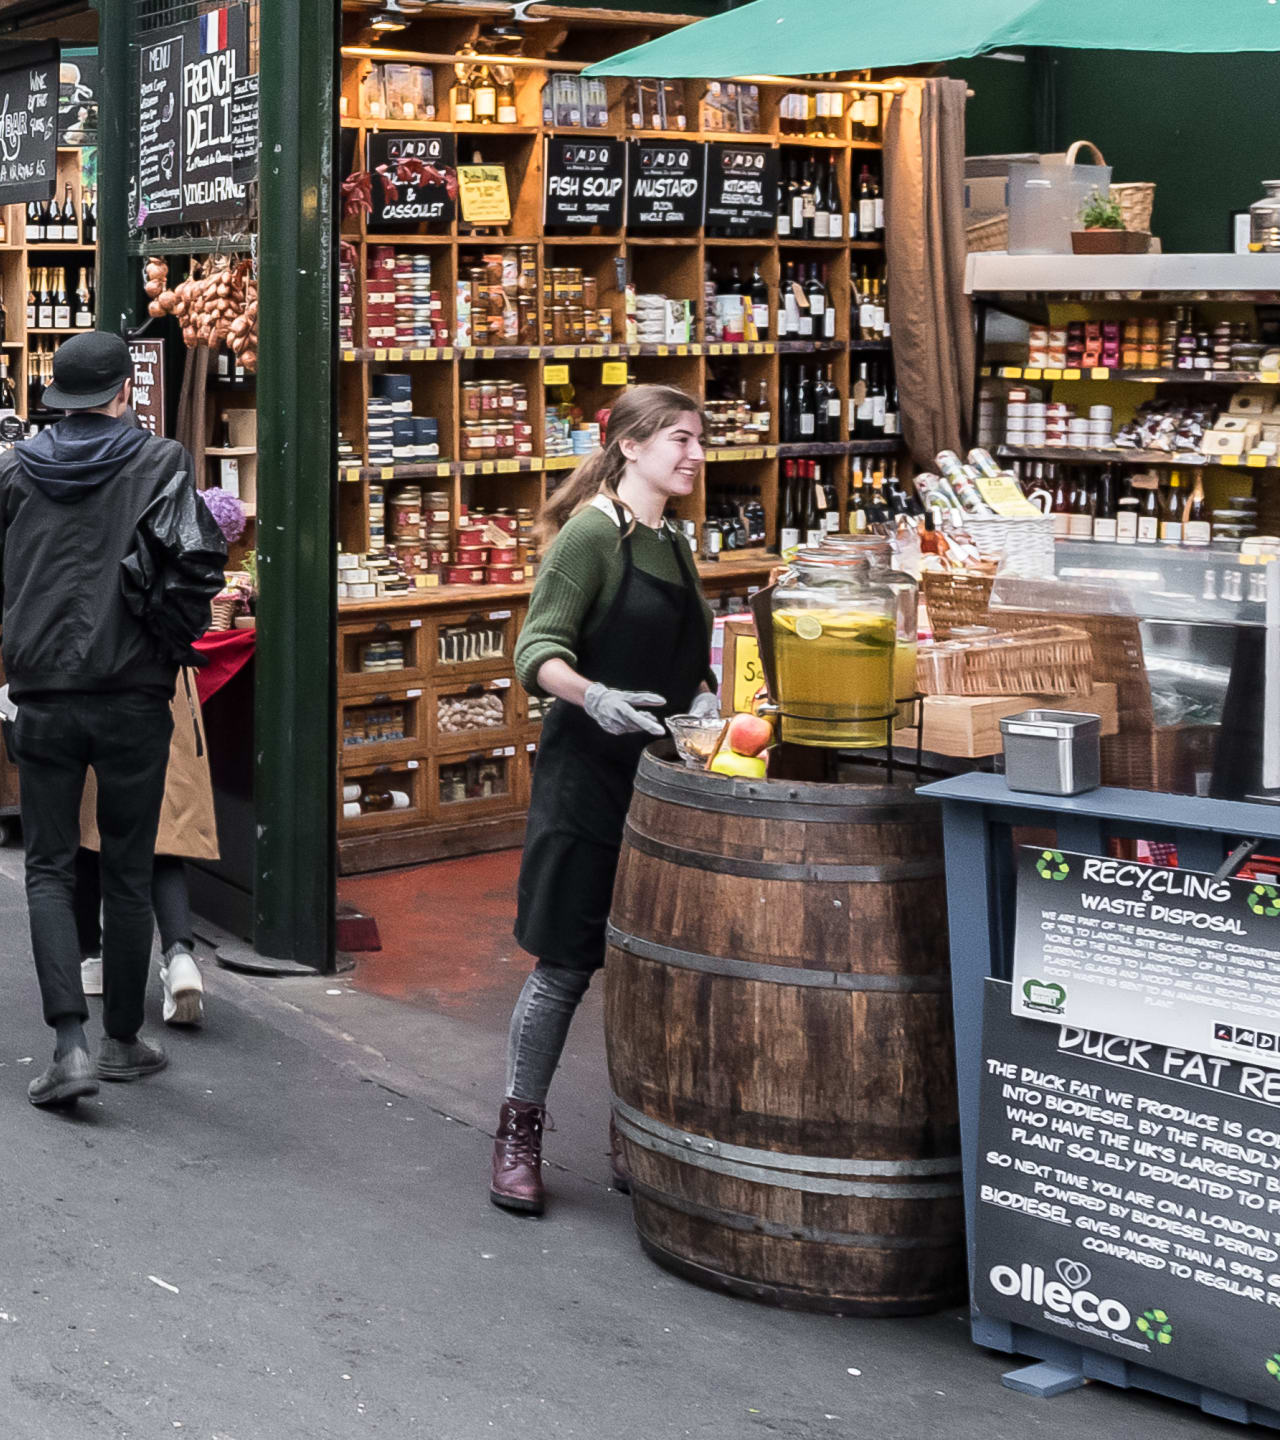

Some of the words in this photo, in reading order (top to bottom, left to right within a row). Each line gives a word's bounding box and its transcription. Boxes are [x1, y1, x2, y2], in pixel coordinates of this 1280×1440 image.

[149, 44, 171, 72] MENU
[184, 49, 236, 108] FRENCH
[186, 96, 232, 156] DELI
[407, 188, 416, 202] &
[549, 176, 580, 197] FISH
[582, 176, 622, 197] SOUP
[634, 178, 698, 198] MUSTARD
[723, 179, 762, 194] KITCHEN
[382, 203, 444, 219] CASSOULET
[1083, 859, 1231, 902] RECYCLING
[1142, 890, 1155, 901] &
[1040, 921, 1056, 930] OF
[1076, 927, 1090, 937] TO
[1091, 930, 1132, 945] LANDFILL
[1135, 939, 1156, 949] SITE
[1041, 910, 1057, 920] WE
[1057, 913, 1076, 924] ARE
[1077, 915, 1101, 927] PART
[1101, 921, 1116, 930] OF
[1117, 923, 1135, 934] THE
[1136, 926, 1184, 942] BOROUGH
[1185, 936, 1224, 950] MARKET
[1081, 893, 1146, 918] WASTE
[1151, 905, 1247, 936] DISPOSAL
[1045, 933, 1072, 945] NONE
[1072, 938, 1088, 947] OF
[1089, 940, 1106, 951] THE
[1198, 961, 1213, 970] OF
[1124, 958, 1139, 968] TO
[1057, 1024, 1152, 1069] DUCK
[1163, 1048, 1231, 1087] FAT
[986, 1059, 1017, 1079] THE
[1021, 1068, 1065, 1092] DUCK
[1070, 1080, 1102, 1101] FAT
[1105, 1089, 1133, 1109] WE
[1137, 1097, 1219, 1131] PRODUCE
[1223, 1120, 1243, 1137] IS
[1002, 1084, 1041, 1105] INTO
[1045, 1094, 1133, 1131] BIODIESEL
[1138, 1119, 1162, 1137] BY
[1166, 1126, 1198, 1147] THE
[1006, 1105, 1047, 1127] WHO
[1051, 1116, 1094, 1141] HAVE
[1099, 1129, 1129, 1149] THE
[1133, 1138, 1176, 1163] UK'S
[1180, 1152, 1264, 1188] LARGEST
[1011, 1128, 1064, 1153] PLANT
[1067, 1144, 1137, 1172] SOLELY
[1139, 1162, 1234, 1200] DEDICATED
[1236, 1190, 1265, 1209] TO
[986, 1151, 1012, 1167] SO
[1014, 1158, 1052, 1179] NEXT
[1054, 1168, 1089, 1189] TIME
[1091, 1179, 1123, 1200] YOU
[1124, 1189, 1156, 1209] ARE
[1157, 1199, 1184, 1218] ON
[1185, 1207, 1198, 1221] A
[1200, 1211, 1270, 1244] LONDON
[981, 1184, 1072, 1224] BIODIESEL
[1075, 1216, 1121, 1239] GIVES
[1123, 1230, 1171, 1253] MORE
[1173, 1244, 1213, 1266] THAN
[1214, 1257, 1227, 1271] A
[1229, 1261, 1264, 1282] 90%
[1034, 1182, 1106, 1211] POWERED
[1109, 1202, 1130, 1220] BY
[1131, 1210, 1210, 1244] BIODIESEL
[1214, 1234, 1279, 1262] DERIVED
[1082, 1236, 1167, 1270] COMPARED
[1168, 1261, 1193, 1279] TO
[1194, 1270, 1265, 1302] REGULAR
[990, 1263, 1131, 1331] olleco
